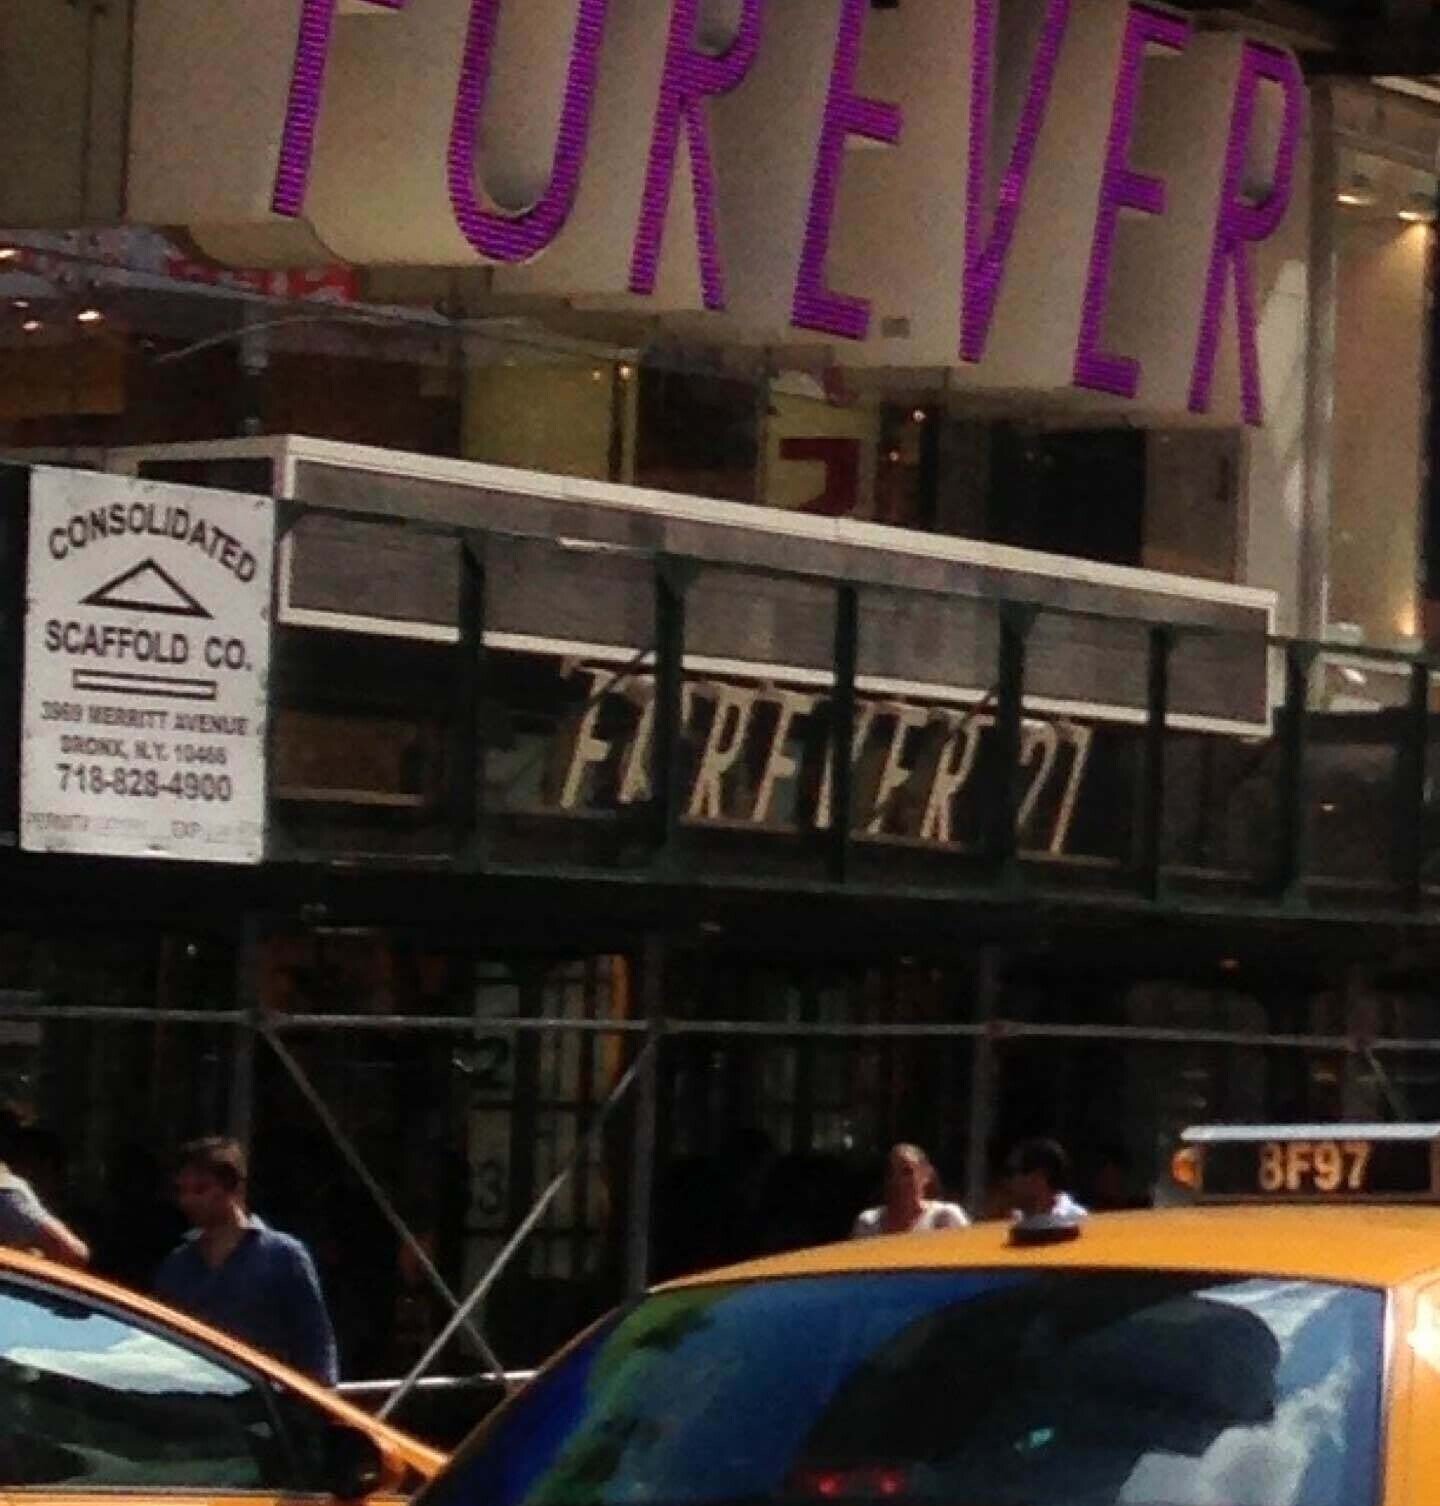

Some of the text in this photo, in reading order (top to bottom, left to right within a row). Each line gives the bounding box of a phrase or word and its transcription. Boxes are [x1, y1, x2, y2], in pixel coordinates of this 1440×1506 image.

[48, 502, 257, 583] CONSOLIDATED
[44, 619, 252, 671] SCAFFOLD CO.
[173, 712, 249, 736] AVENUE
[55, 762, 233, 802] 718-828-4900
[1259, 1140, 1373, 1190] 8F97
